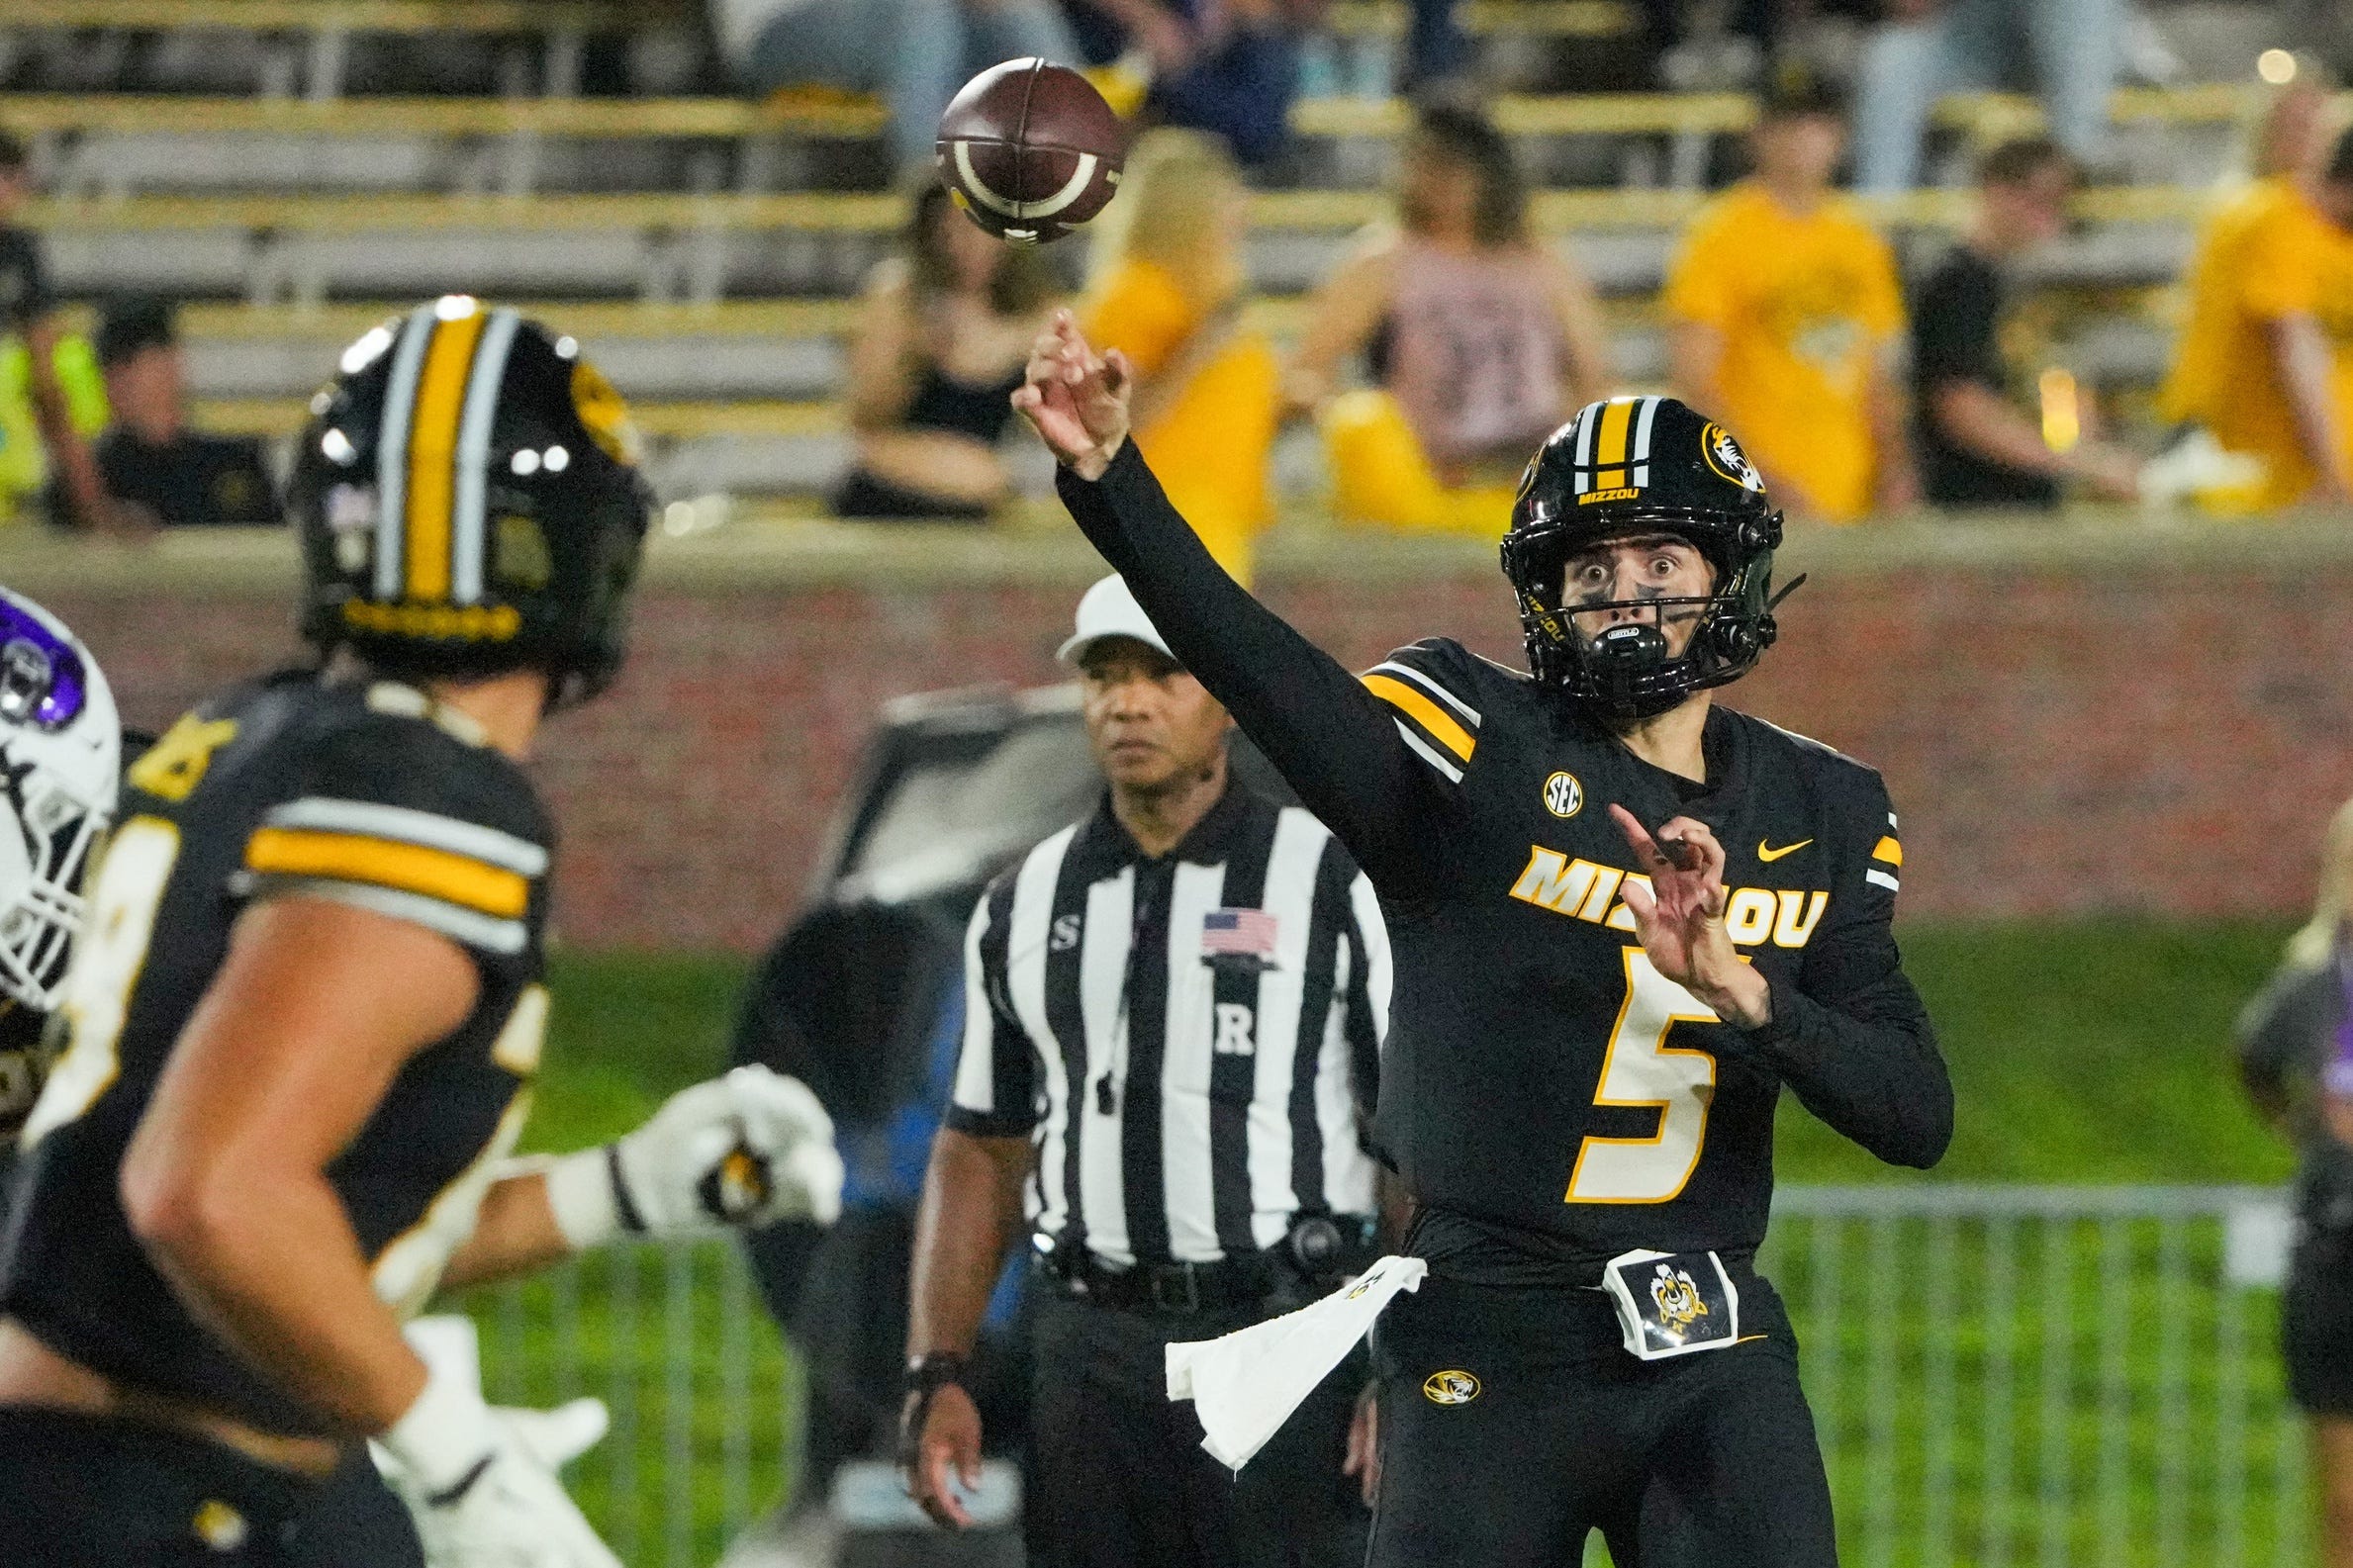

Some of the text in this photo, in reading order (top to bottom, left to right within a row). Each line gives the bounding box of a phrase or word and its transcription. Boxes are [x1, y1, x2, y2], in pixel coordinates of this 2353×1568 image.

[1578, 488, 1640, 506] MIZZOU
[1547, 775, 1580, 815] SEC
[1051, 914, 1080, 951] S
[1215, 1002, 1255, 1057] R
[1564, 945, 1752, 1204] 5
